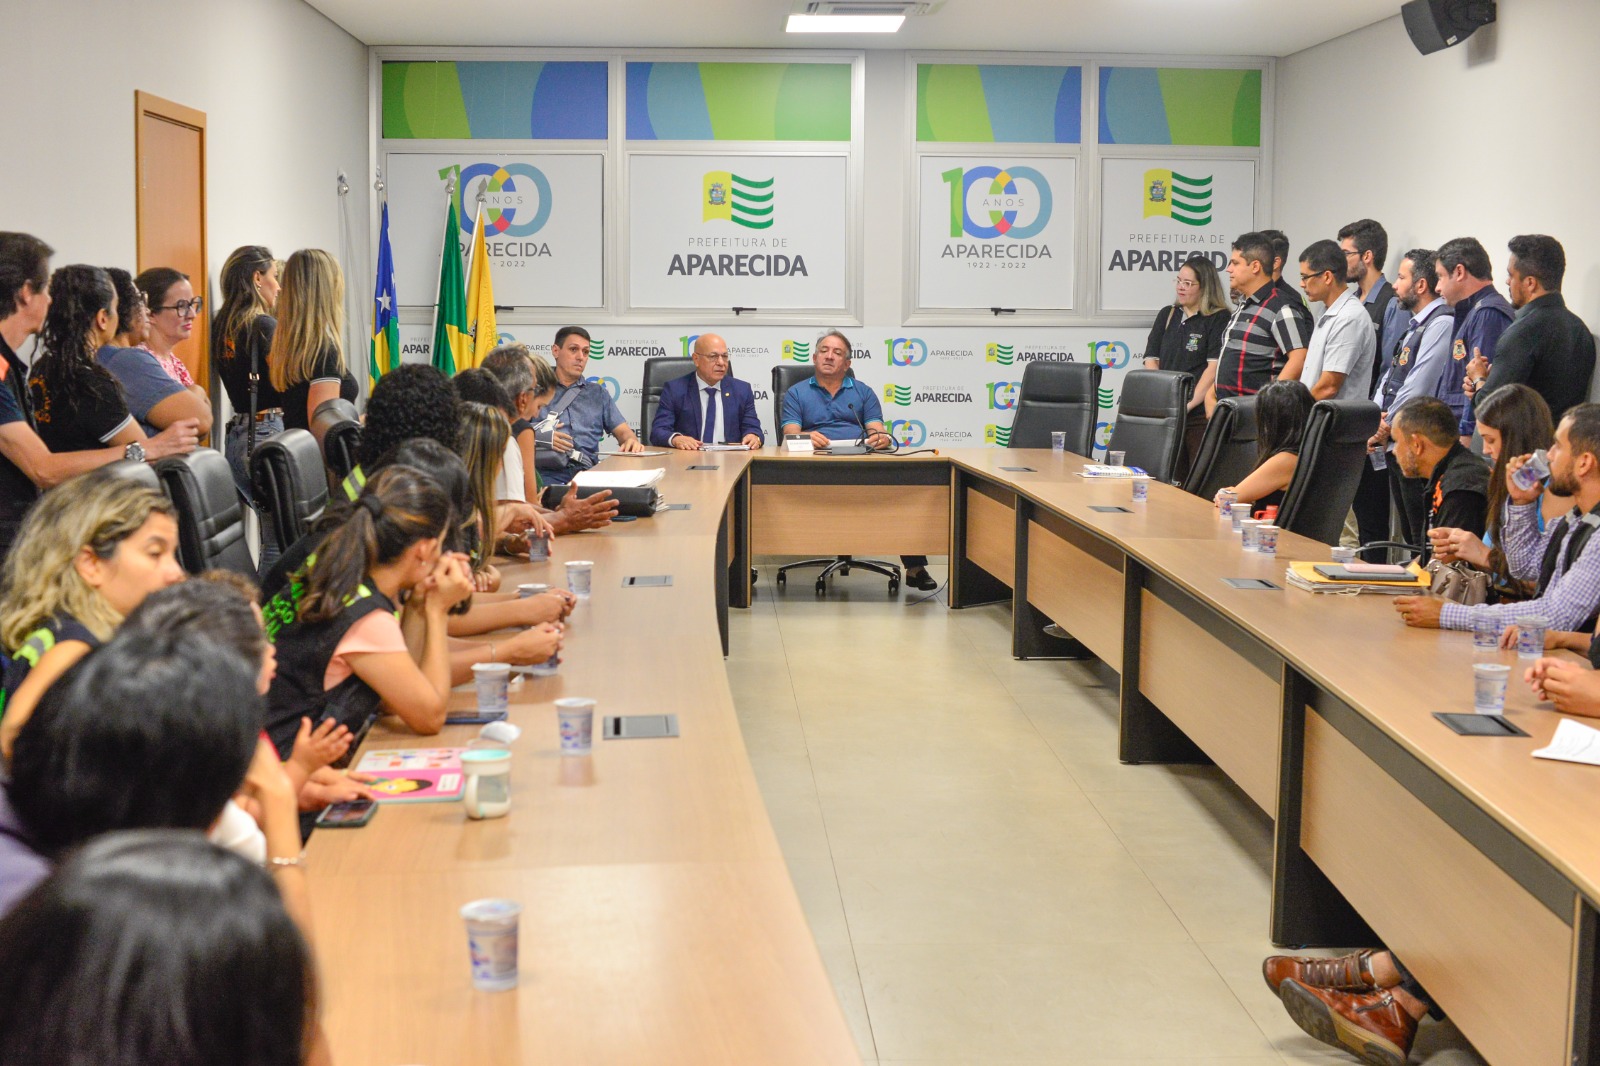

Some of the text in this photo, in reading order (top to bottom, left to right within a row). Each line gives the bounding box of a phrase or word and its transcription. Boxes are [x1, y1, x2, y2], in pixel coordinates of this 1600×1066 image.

[941, 166, 1053, 239] 100
[982, 198, 1025, 207] ANOS
[688, 237, 788, 247] PREFEITURA DE
[1129, 234, 1225, 244] PREFEITURA DE
[941, 244, 1053, 259] APARECIDA
[667, 253, 808, 277] APARECIDA
[607, 346, 667, 357] APARECIDA
[885, 338, 928, 366] 100
[1016, 352, 1075, 362] APARECIDA
[914, 392, 973, 403] APARECIDA
